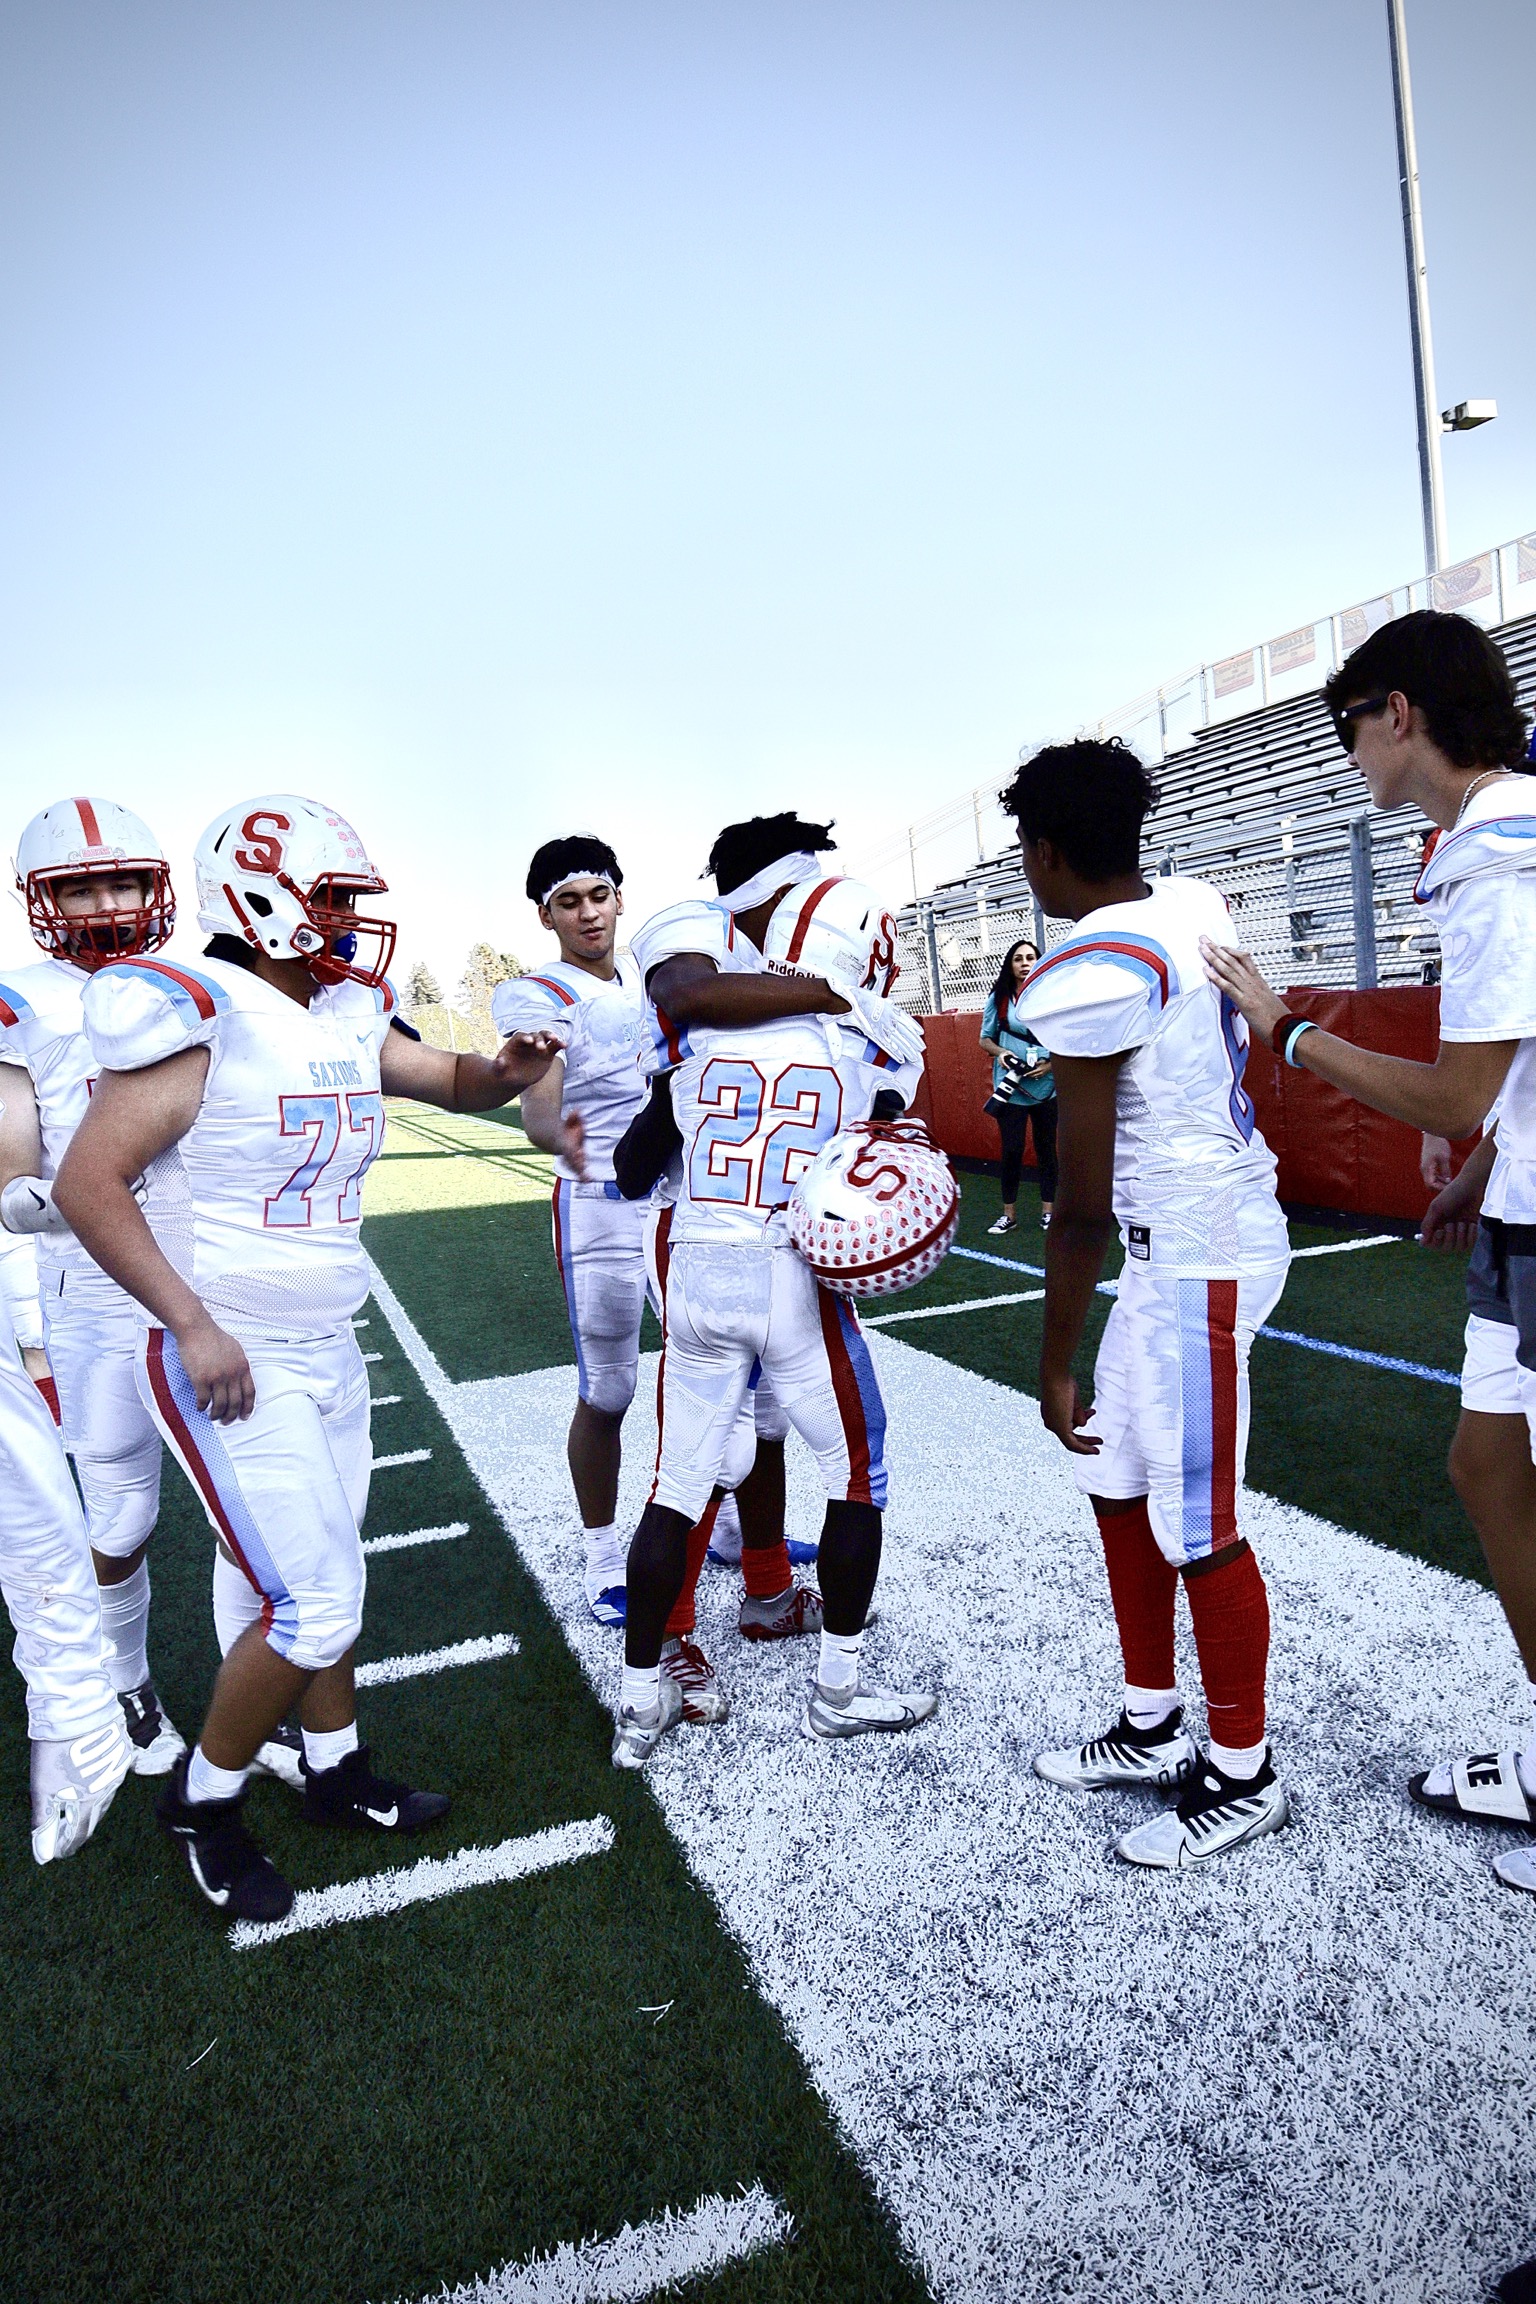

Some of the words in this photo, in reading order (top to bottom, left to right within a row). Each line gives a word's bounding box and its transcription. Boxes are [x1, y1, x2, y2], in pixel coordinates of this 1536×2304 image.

[233, 809, 293, 875] S
[308, 1059, 363, 1088] SAXONS
[263, 1091, 386, 1228] 77
[688, 1057, 844, 1211] 22
[1133, 1230, 1142, 1241] M
[1465, 1752, 1503, 1788] KE
